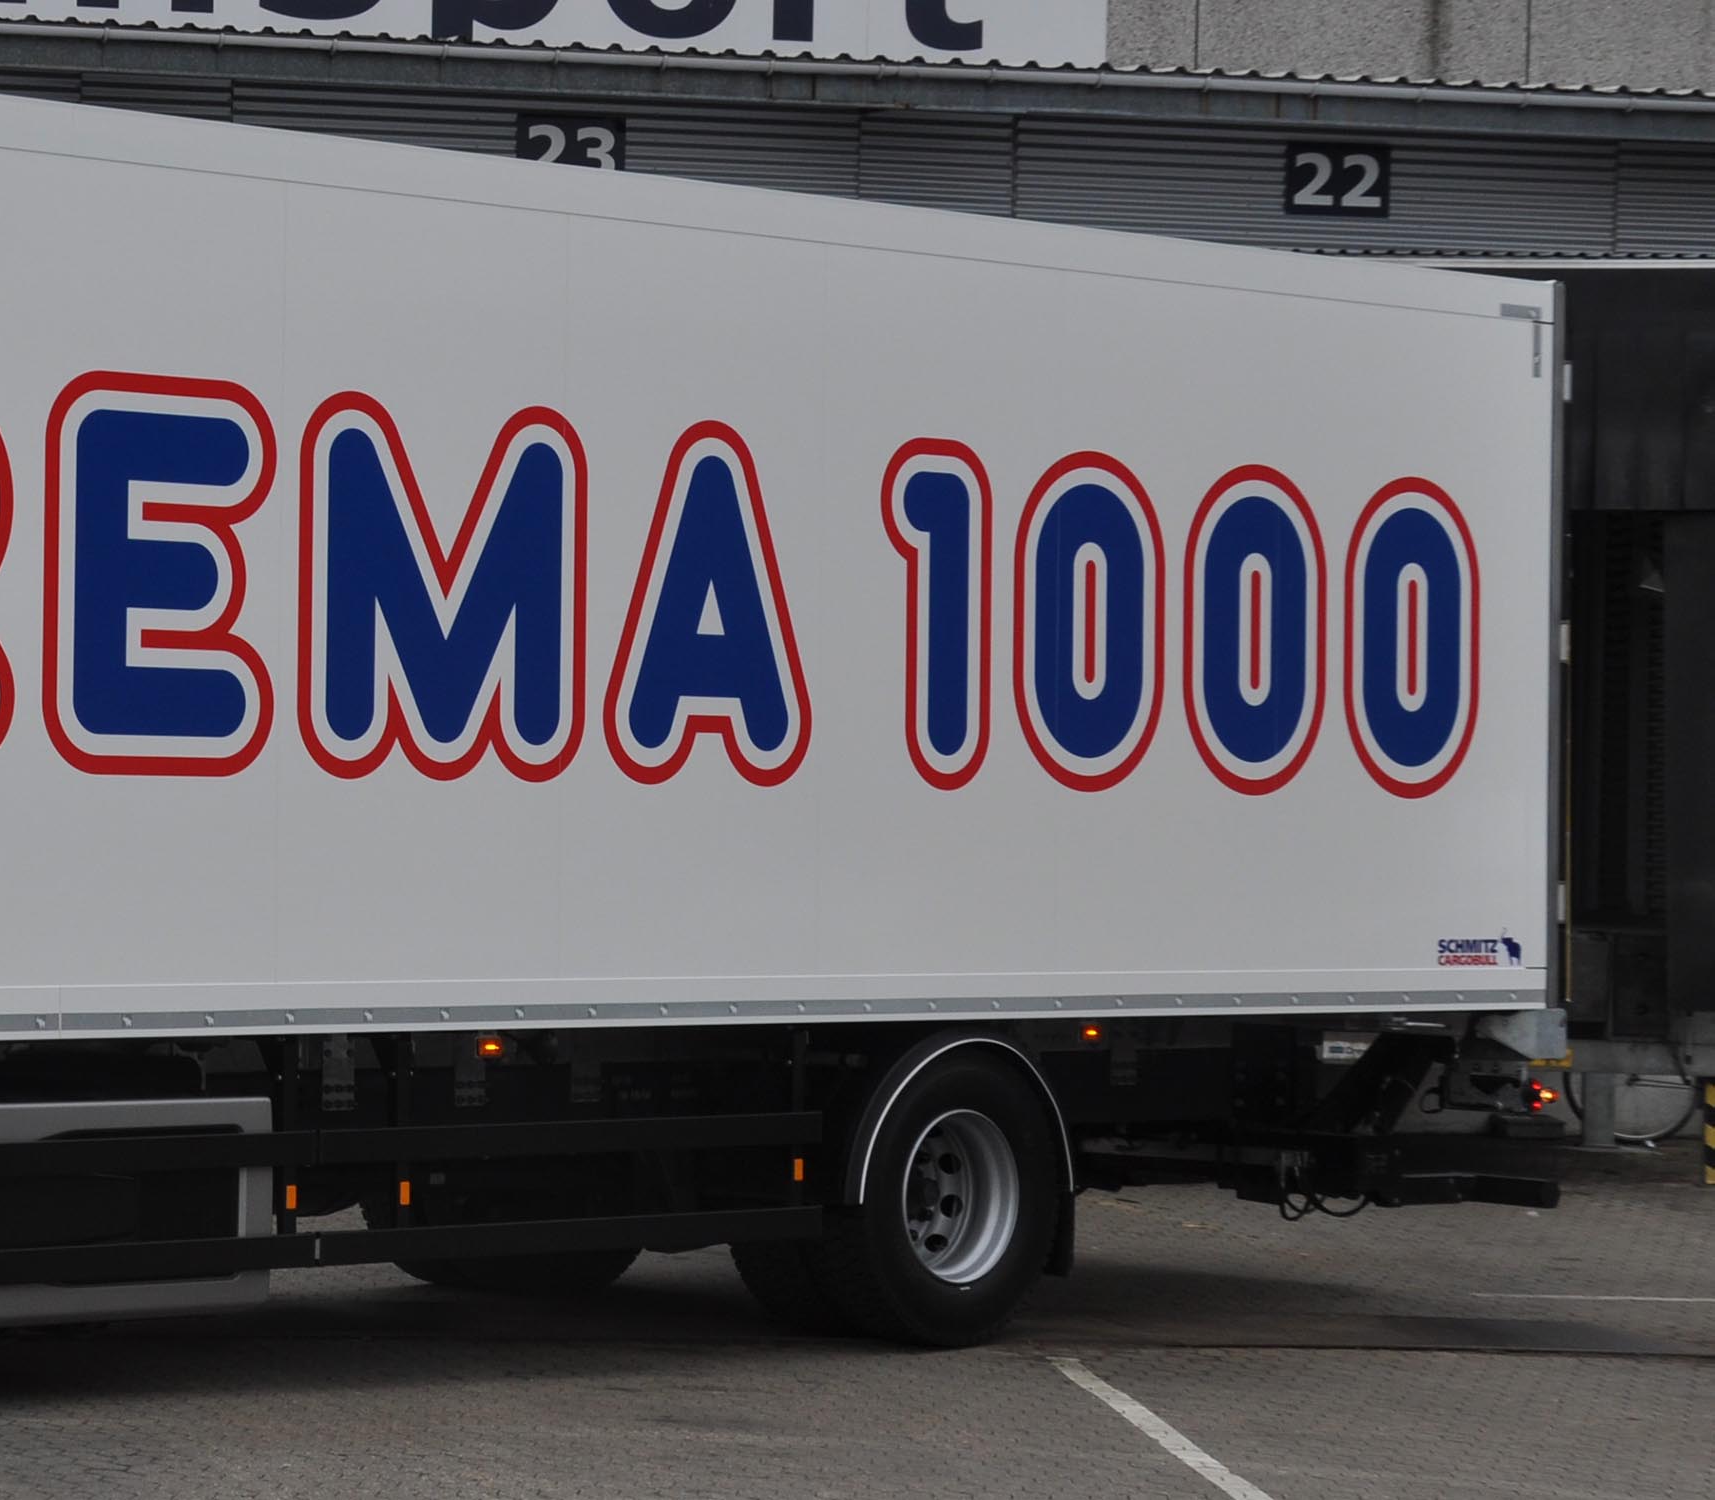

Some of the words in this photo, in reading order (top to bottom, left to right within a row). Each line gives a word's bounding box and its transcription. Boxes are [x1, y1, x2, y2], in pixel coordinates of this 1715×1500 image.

[1293, 152, 1382, 208] 22
[881, 436, 1481, 799] 1000
[1438, 939, 1498, 953] SCHMITZ
